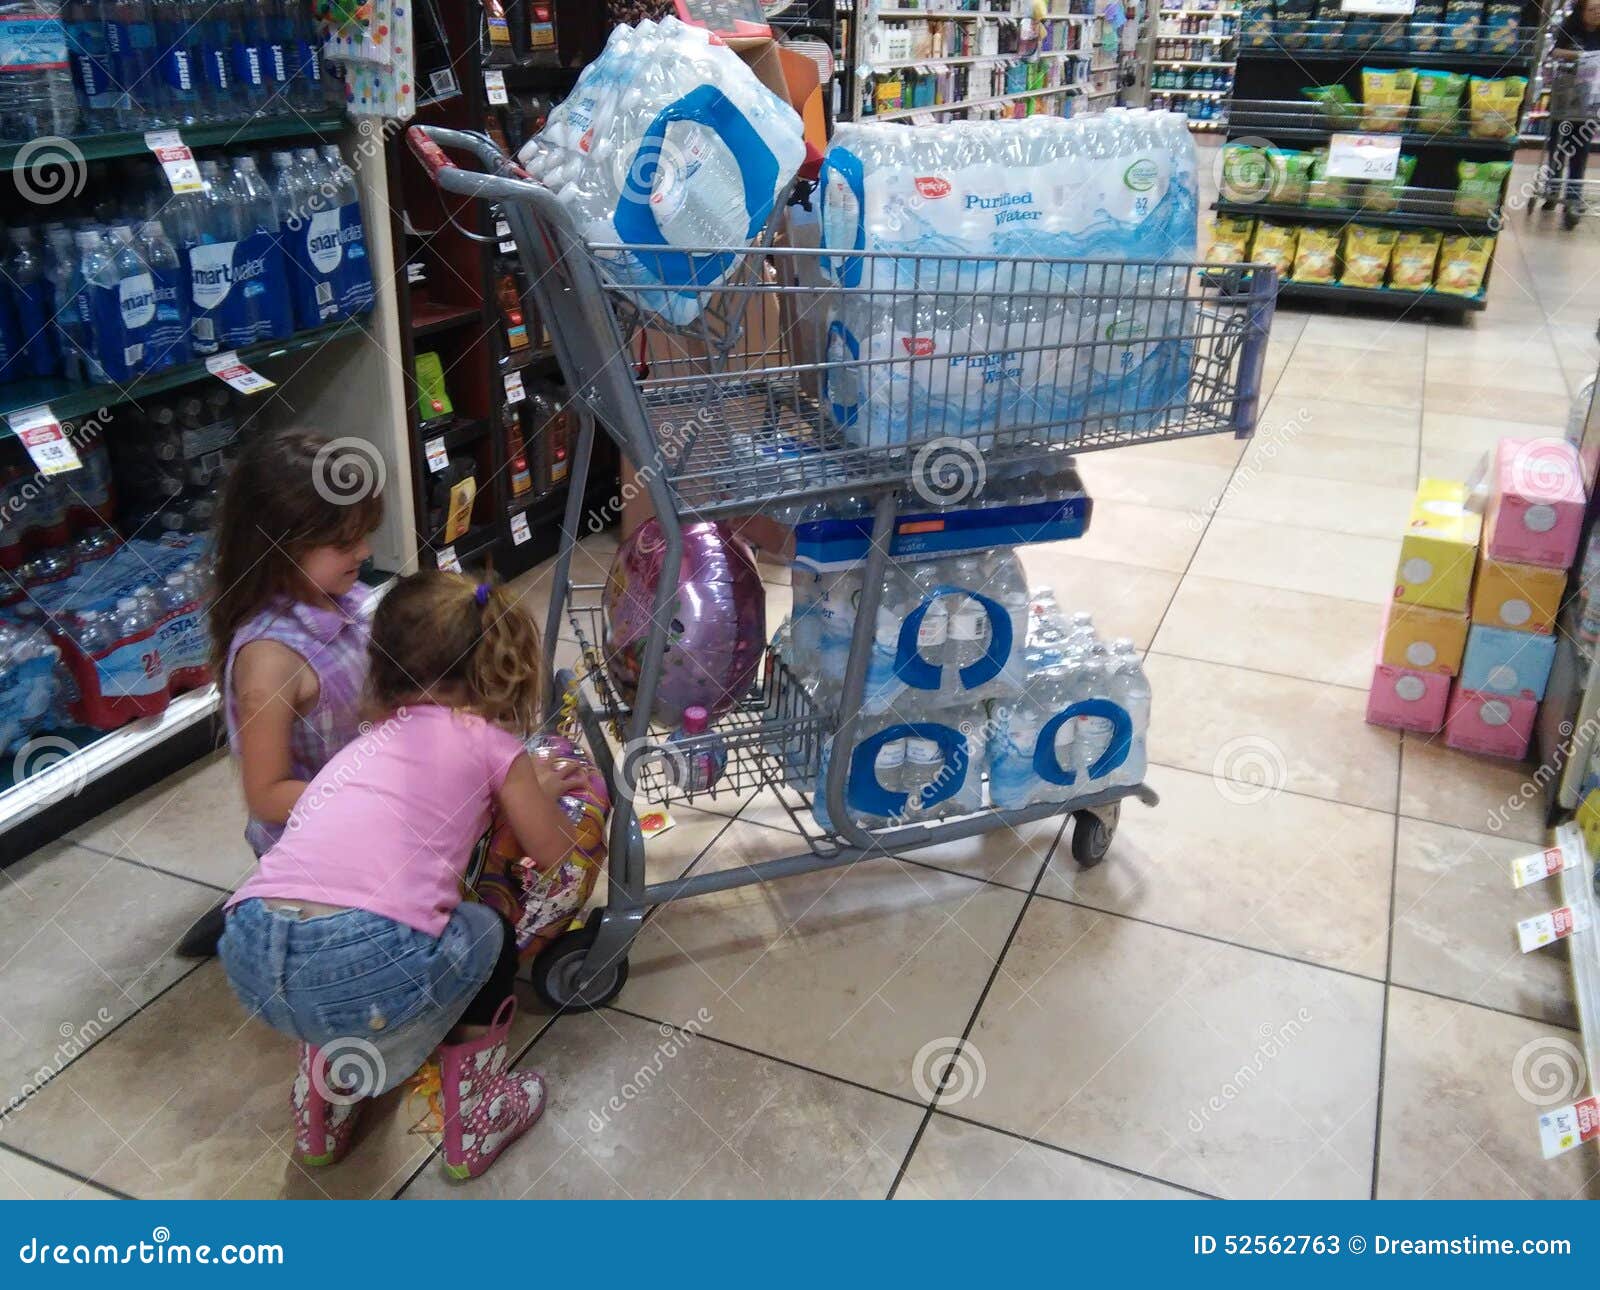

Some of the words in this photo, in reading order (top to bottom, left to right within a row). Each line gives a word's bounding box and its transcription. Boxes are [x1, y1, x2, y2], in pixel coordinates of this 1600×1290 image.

[80, 55, 96, 95] smart
[174, 50, 191, 90] smart
[214, 50, 227, 88] smart
[246, 47, 261, 85] smart
[272, 45, 285, 81] smart
[965, 191, 1034, 209] Purified
[995, 209, 1043, 226] Water
